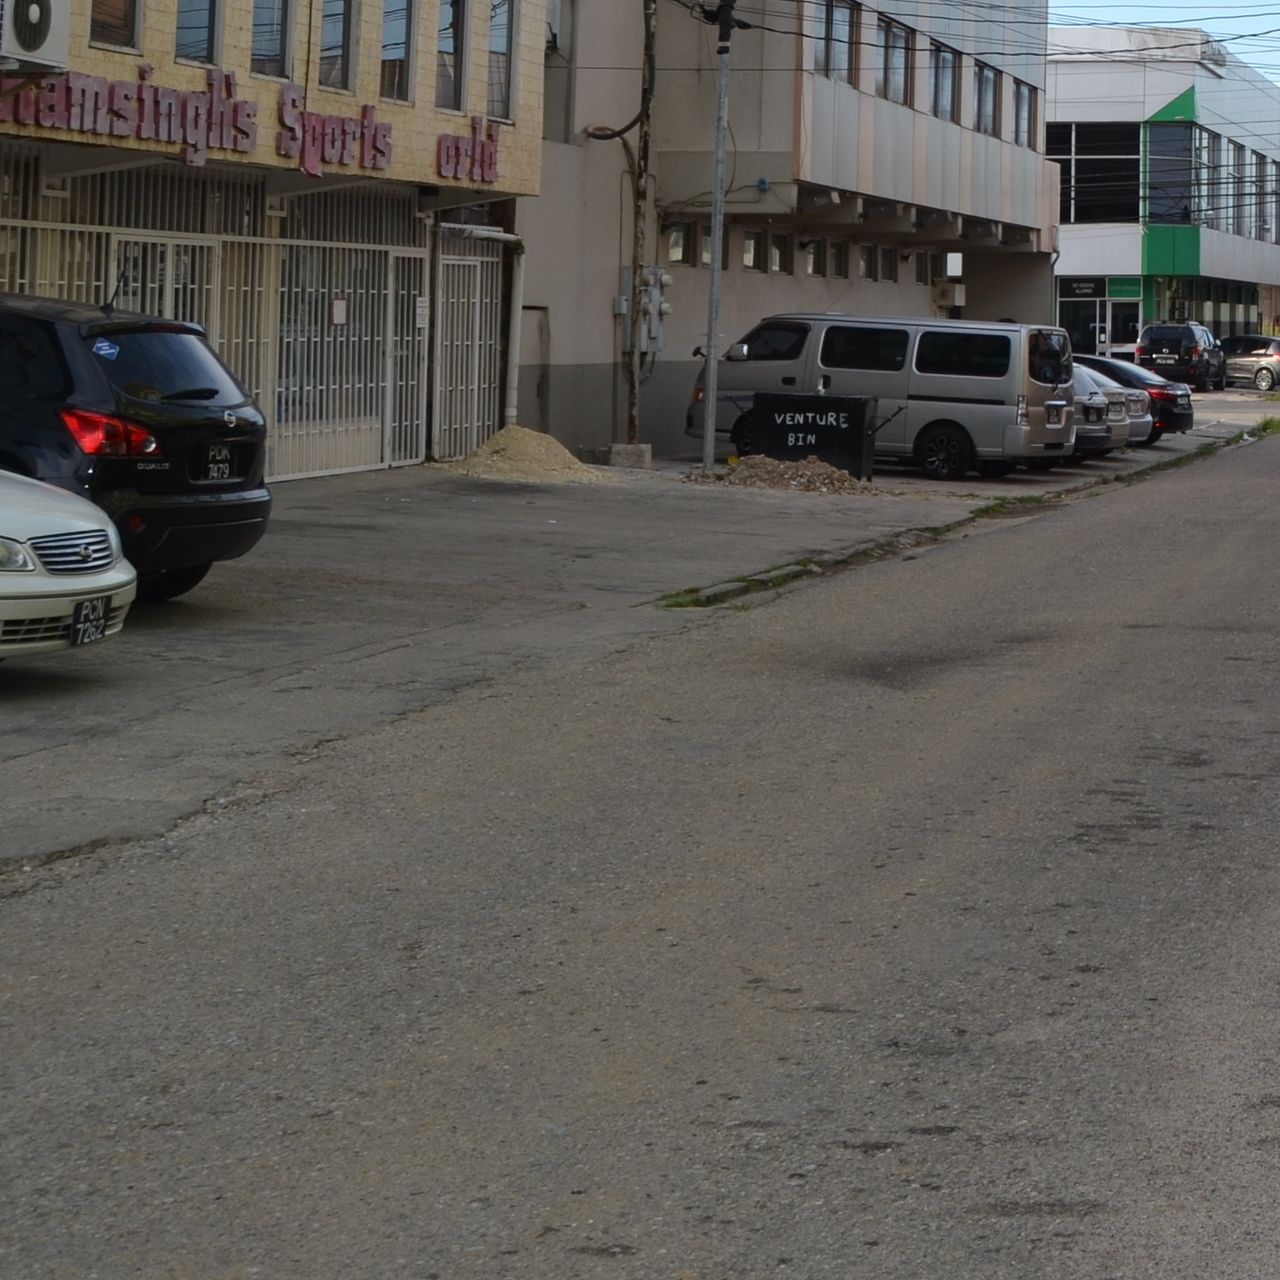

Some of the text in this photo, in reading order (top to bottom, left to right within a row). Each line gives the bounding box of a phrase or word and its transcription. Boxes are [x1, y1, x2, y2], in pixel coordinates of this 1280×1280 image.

[773, 411, 849, 428] VENTURE
[787, 432, 816, 446] BIN
[209, 445, 231, 460] PDK
[81, 596, 106, 622] PCN
[76, 620, 105, 645] 7262
